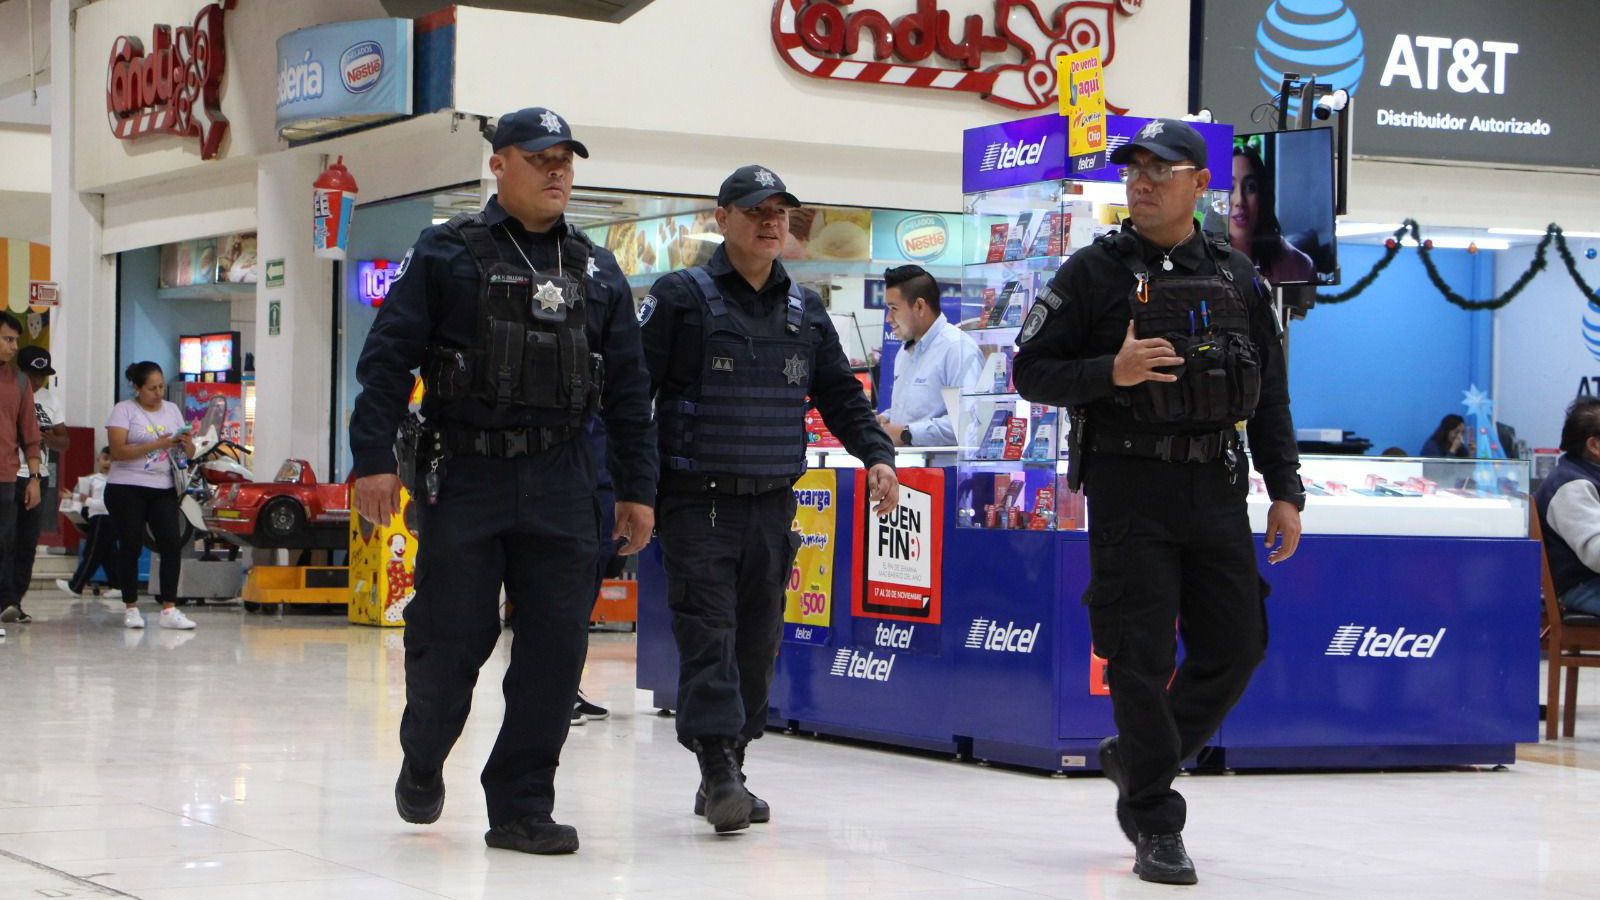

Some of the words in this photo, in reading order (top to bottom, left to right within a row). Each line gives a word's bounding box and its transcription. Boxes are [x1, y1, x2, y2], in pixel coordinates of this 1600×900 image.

[1071, 61, 1080, 73] De
[1081, 57, 1098, 70] venta
[1380, 34, 1518, 95] AT&T
[1079, 72, 1100, 98] aquí
[1088, 129, 1101, 142] Chip
[1377, 109, 1467, 131] Distribuidor
[1470, 115, 1551, 136] Autorizado
[997, 135, 1048, 169] telcel
[1077, 155, 1097, 171] telcel
[365, 268, 399, 297] ICE
[793, 488, 831, 511] ecarga
[795, 626, 813, 640] telcel
[875, 622, 914, 649] telcel
[984, 622, 1041, 653] telcel
[1357, 627, 1446, 658] telcel
[847, 650, 895, 682] telcel
